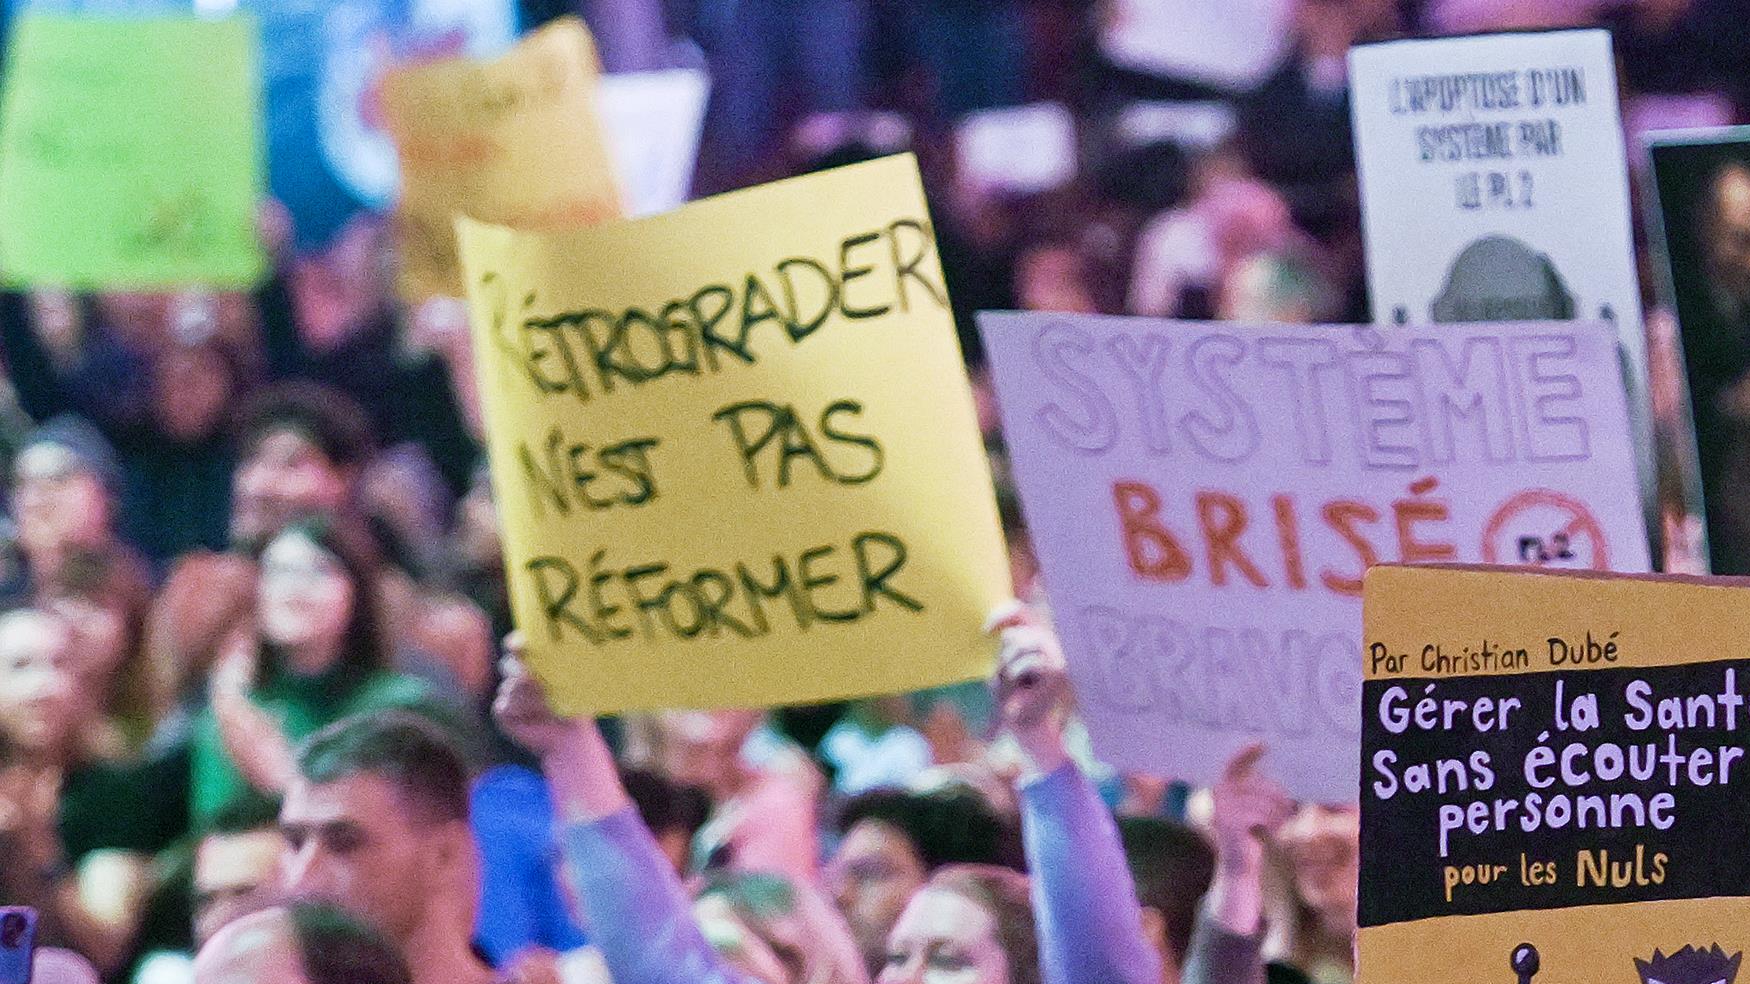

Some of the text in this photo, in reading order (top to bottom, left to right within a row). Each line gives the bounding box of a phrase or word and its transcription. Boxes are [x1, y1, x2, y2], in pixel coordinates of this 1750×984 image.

[482, 219, 949, 401] RÉTROGRADER
[1032, 321, 1591, 470] SYSTÈME
[713, 399, 884, 488] PAS
[1112, 476, 1457, 598] BRISÉ
[526, 531, 923, 646] RÉFORMER
[1371, 631, 1620, 674] Par Christian Dubé
[1379, 683, 1521, 734] Gérer
[1554, 680, 1599, 732] la
[1373, 731, 1745, 800] Sans écouter
[1440, 791, 1676, 857] personne
[1444, 844, 1669, 902] pour les Nuls
